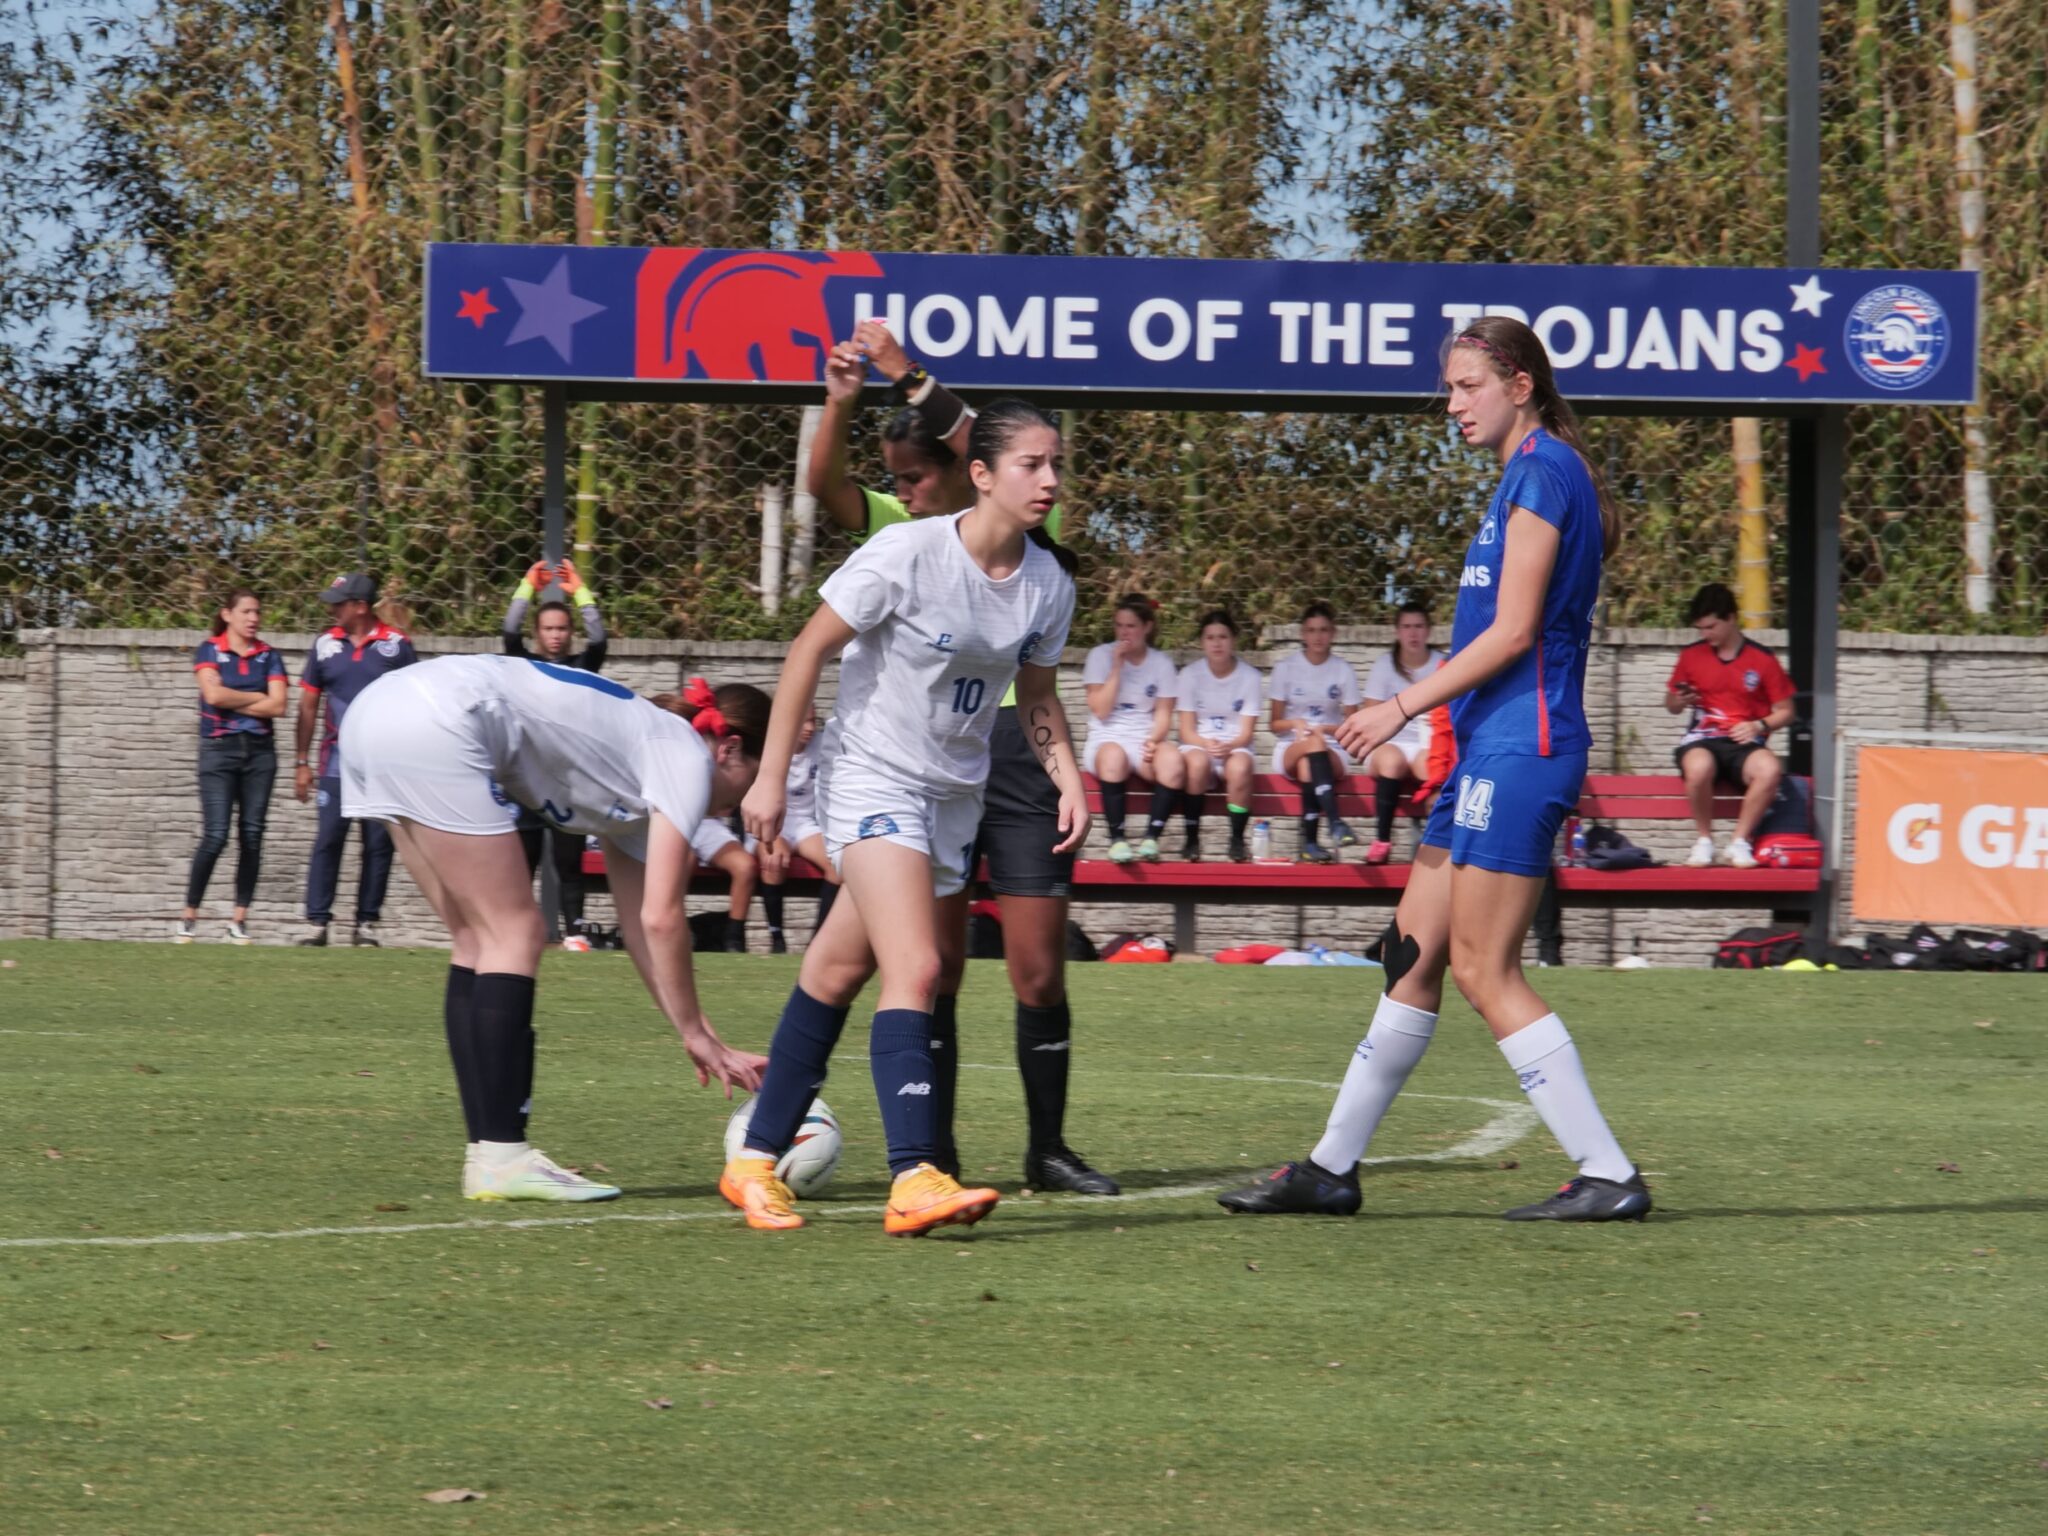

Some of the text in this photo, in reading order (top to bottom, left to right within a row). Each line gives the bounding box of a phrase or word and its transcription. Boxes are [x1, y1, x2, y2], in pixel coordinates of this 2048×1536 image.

[854, 293, 1785, 373] HOME OF THE TOJANS
[952, 677, 985, 715] 10
[1454, 775, 1495, 831] 14
[1887, 803, 1942, 864] G
